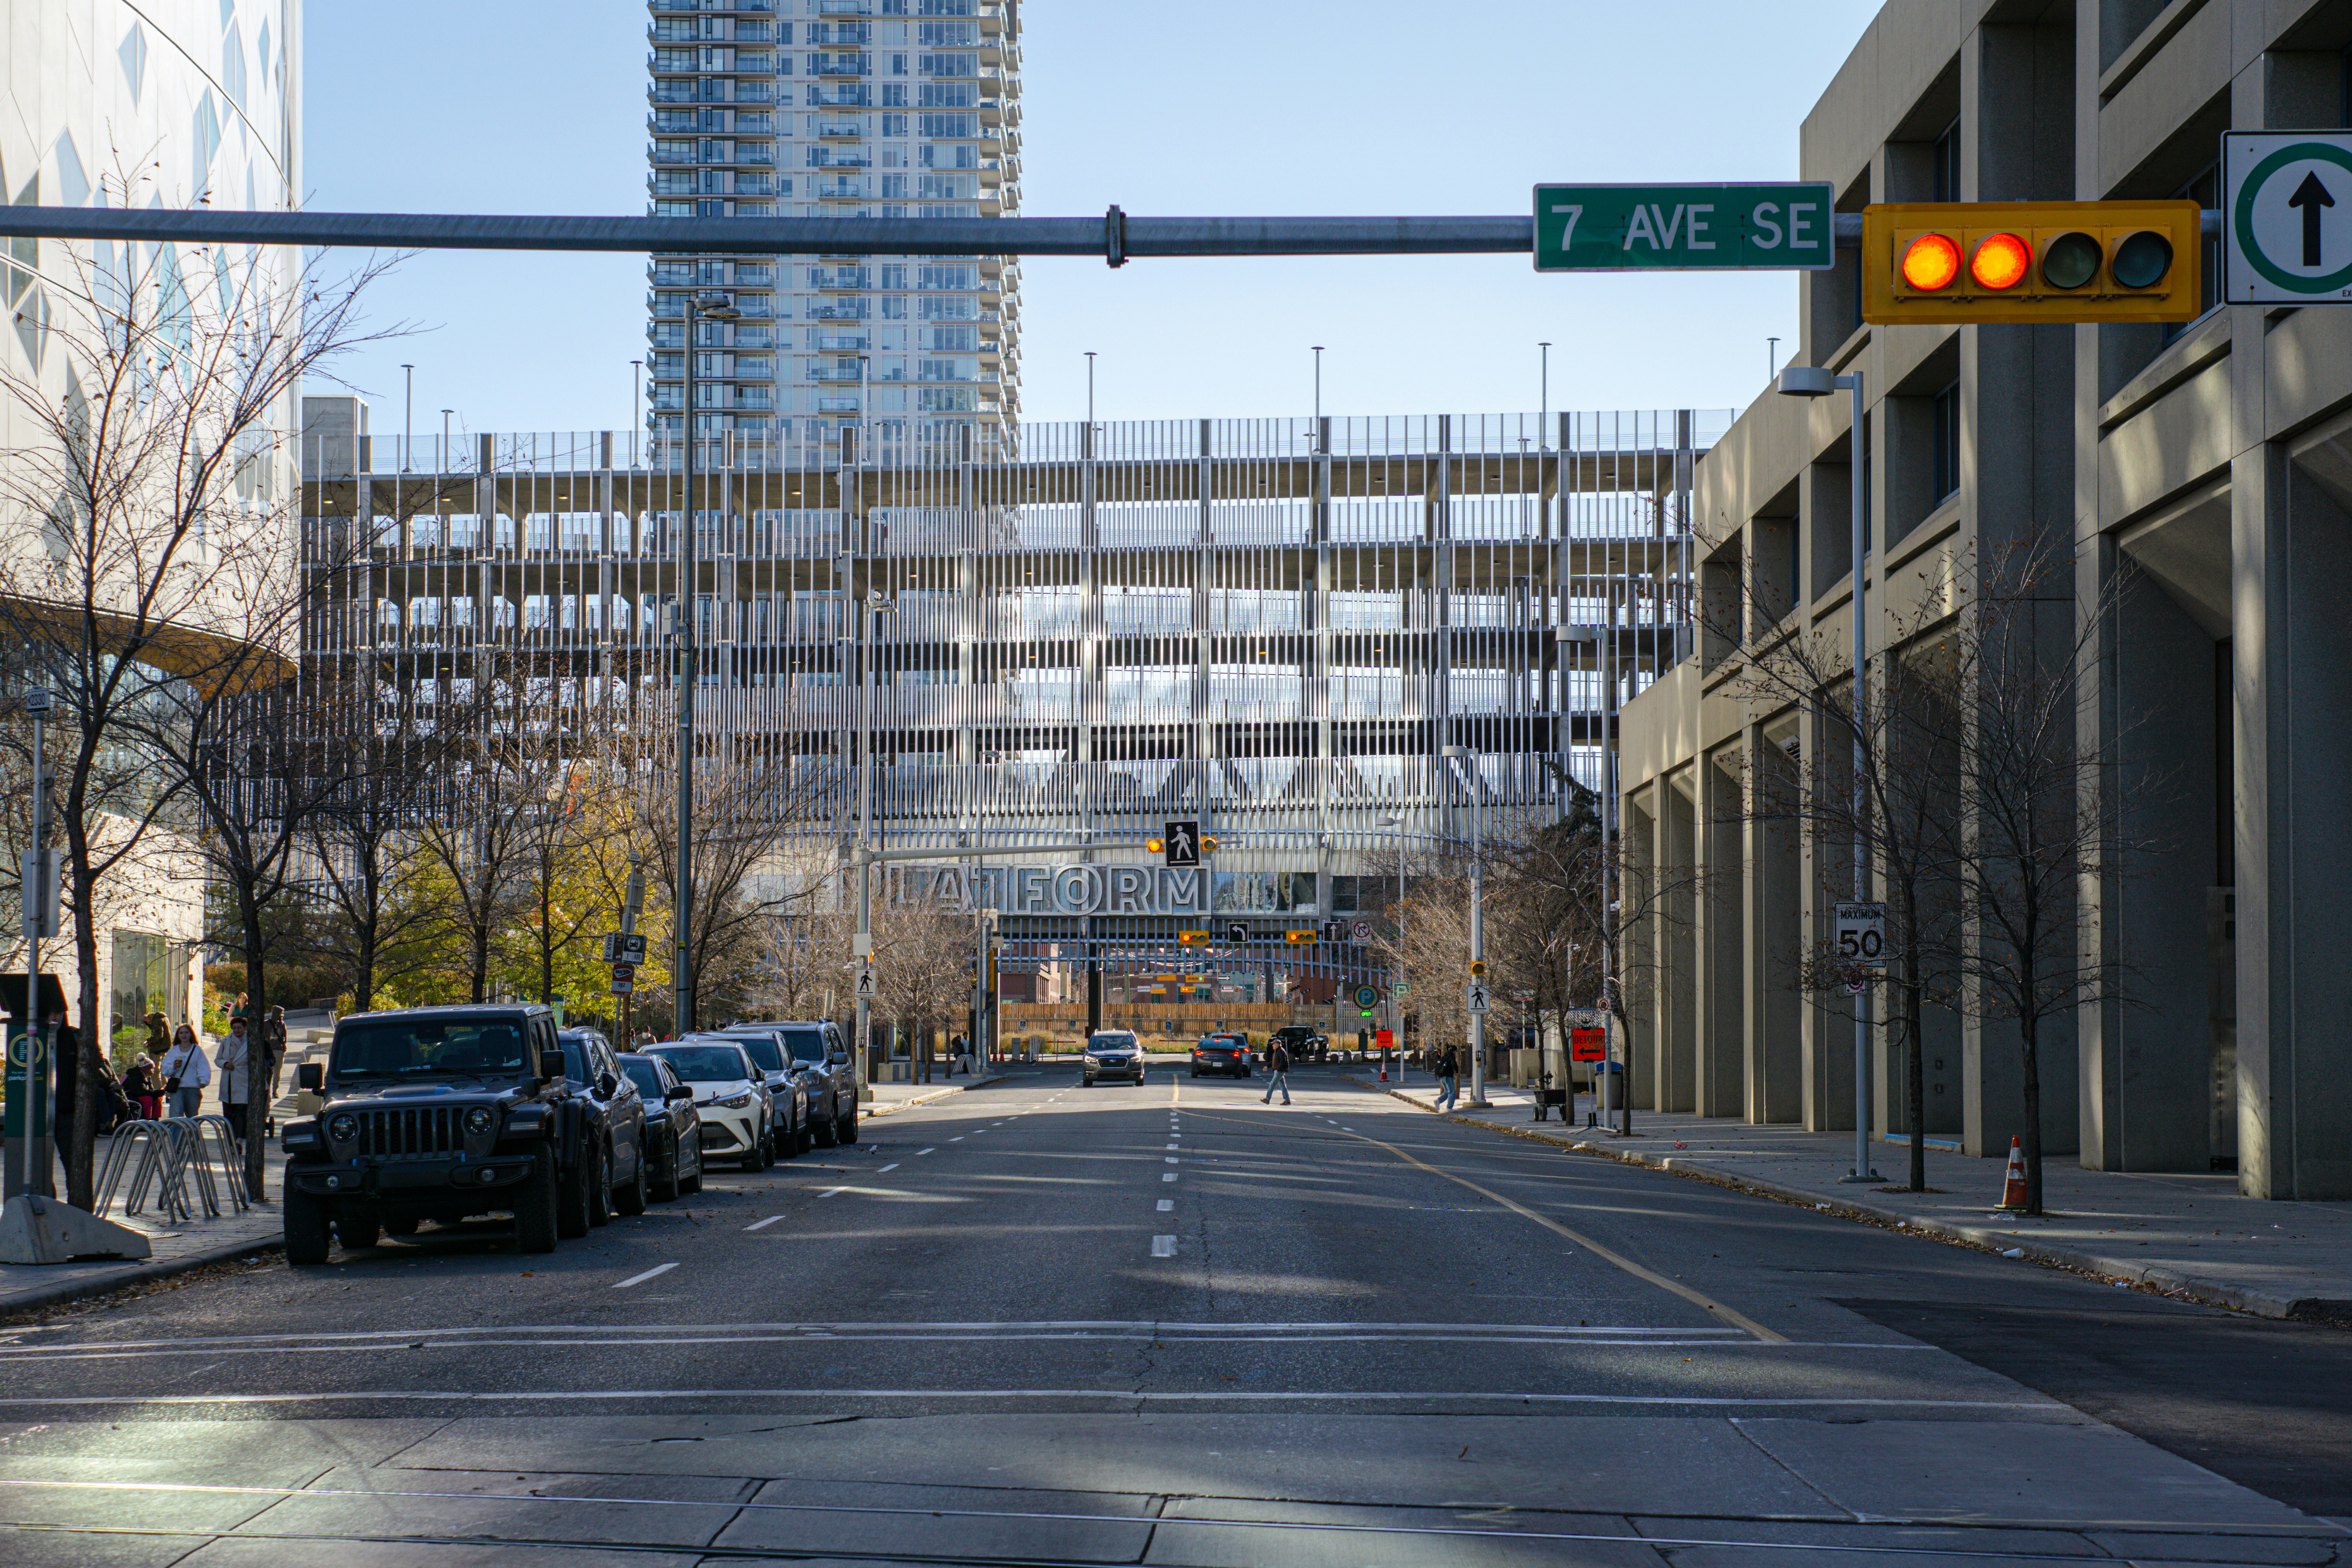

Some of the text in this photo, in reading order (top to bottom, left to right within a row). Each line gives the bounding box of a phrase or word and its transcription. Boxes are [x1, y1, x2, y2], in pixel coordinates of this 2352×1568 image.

[1551, 202, 1818, 251] 7 AVE SE
[31, 693, 46, 706] 2330
[1840, 910, 1880, 920] MAXIMUM
[1839, 929, 1882, 958] 50
[1575, 1035, 1603, 1044] DETOUR
